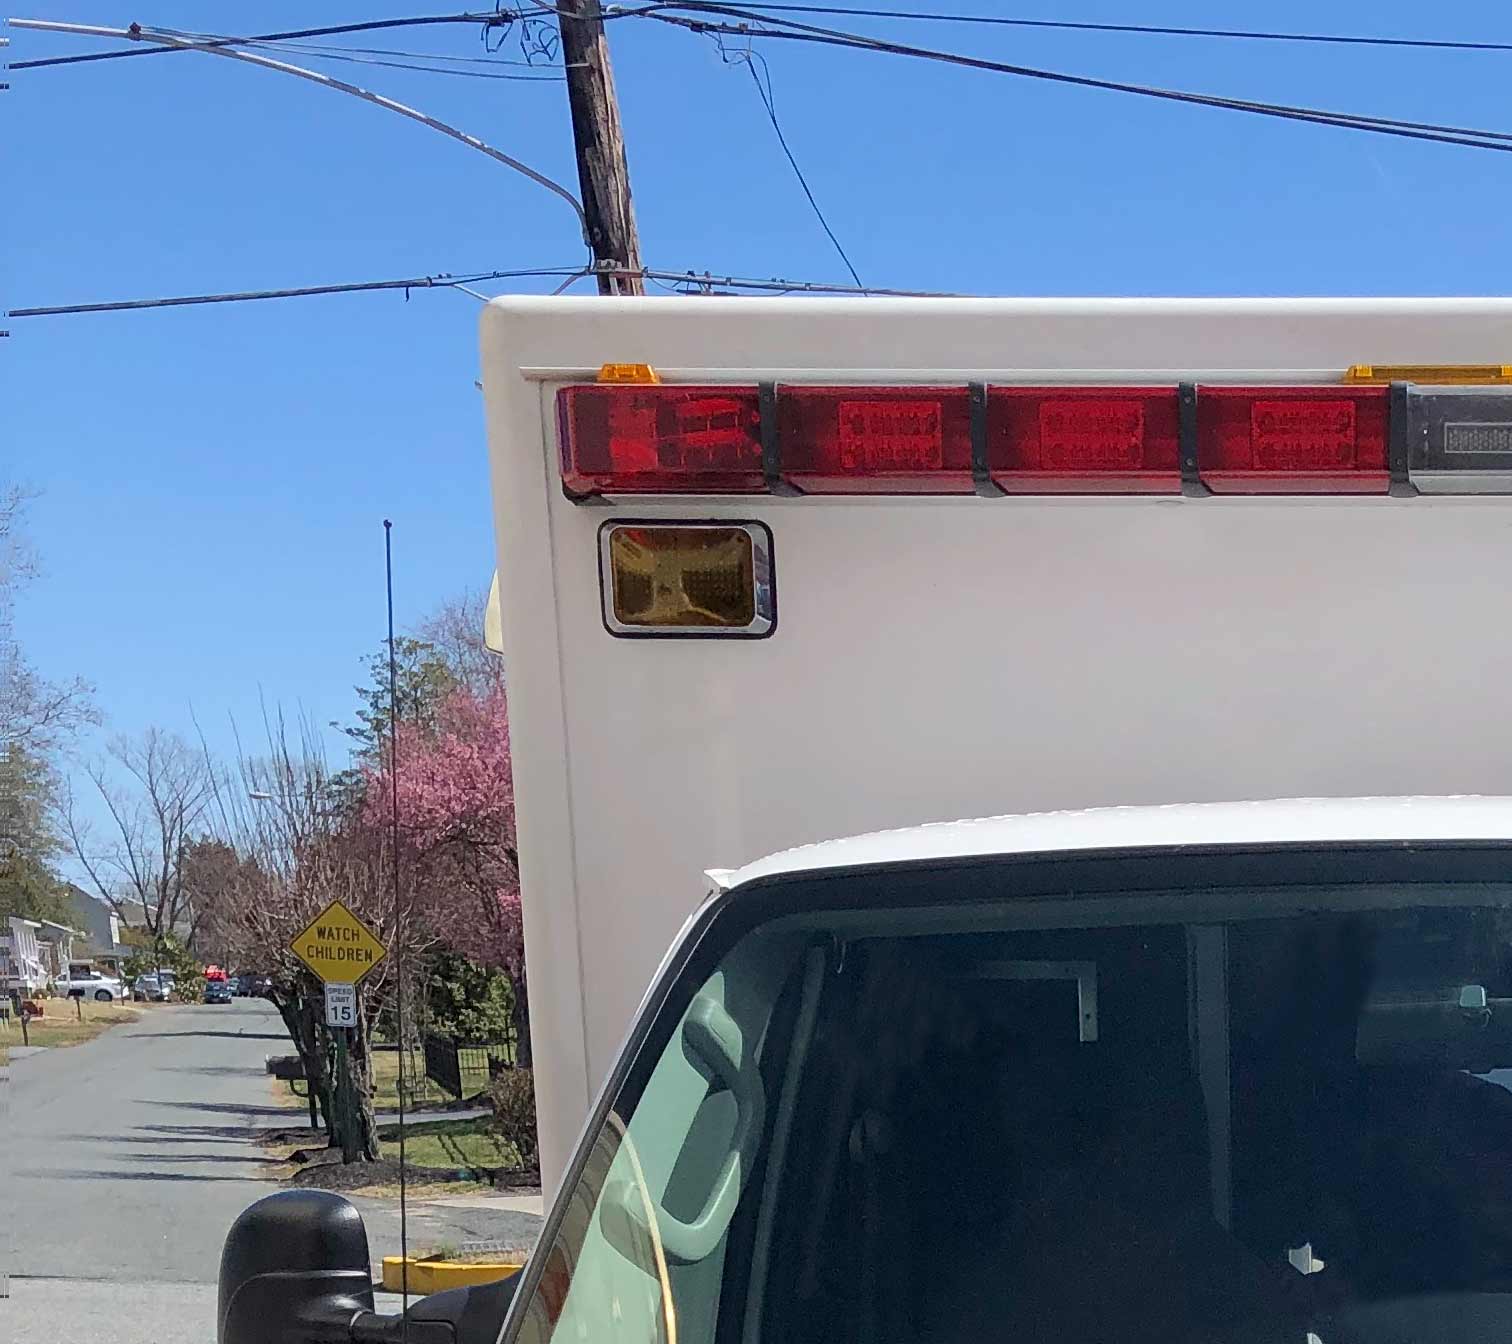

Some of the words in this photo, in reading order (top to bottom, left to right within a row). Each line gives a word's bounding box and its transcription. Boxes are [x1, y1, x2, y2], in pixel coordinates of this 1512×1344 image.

[317, 926, 360, 942] WATCH
[306, 945, 373, 962] CHILDREN
[331, 1006, 351, 1021] 15
